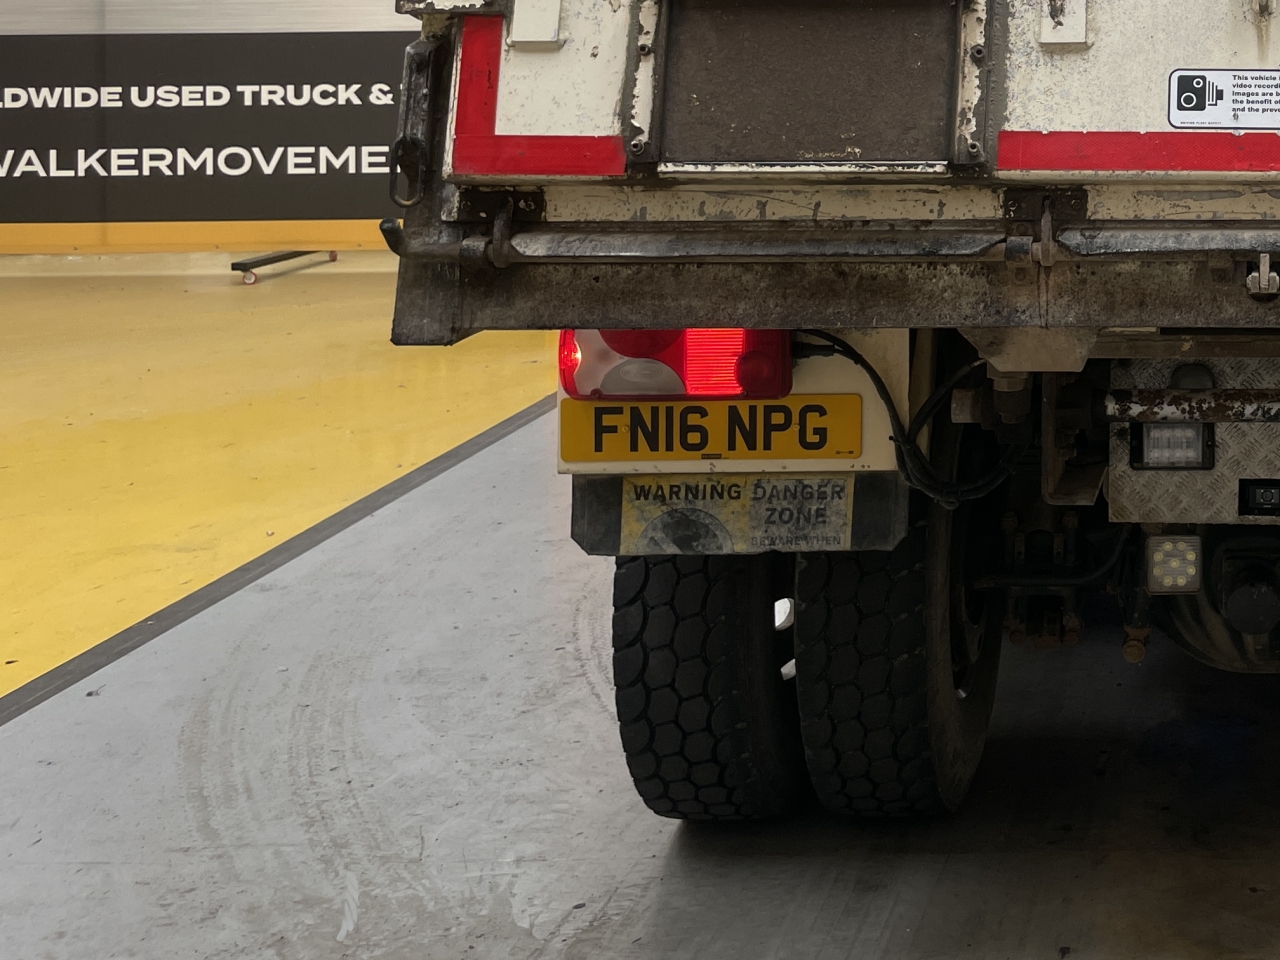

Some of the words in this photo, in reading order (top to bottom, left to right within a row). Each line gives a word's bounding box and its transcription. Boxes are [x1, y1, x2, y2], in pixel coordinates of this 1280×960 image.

[0, 86, 123, 108] DWIDE
[130, 85, 231, 108] USED
[236, 84, 362, 107] TRUCK
[369, 83, 394, 105] &
[0, 146, 401, 177] ALKERMOVEME
[594, 404, 709, 453] FN16
[727, 404, 828, 451] NPG
[634, 483, 742, 501] WARNING
[752, 484, 845, 501] DANGER
[764, 507, 827, 525] ZONE
